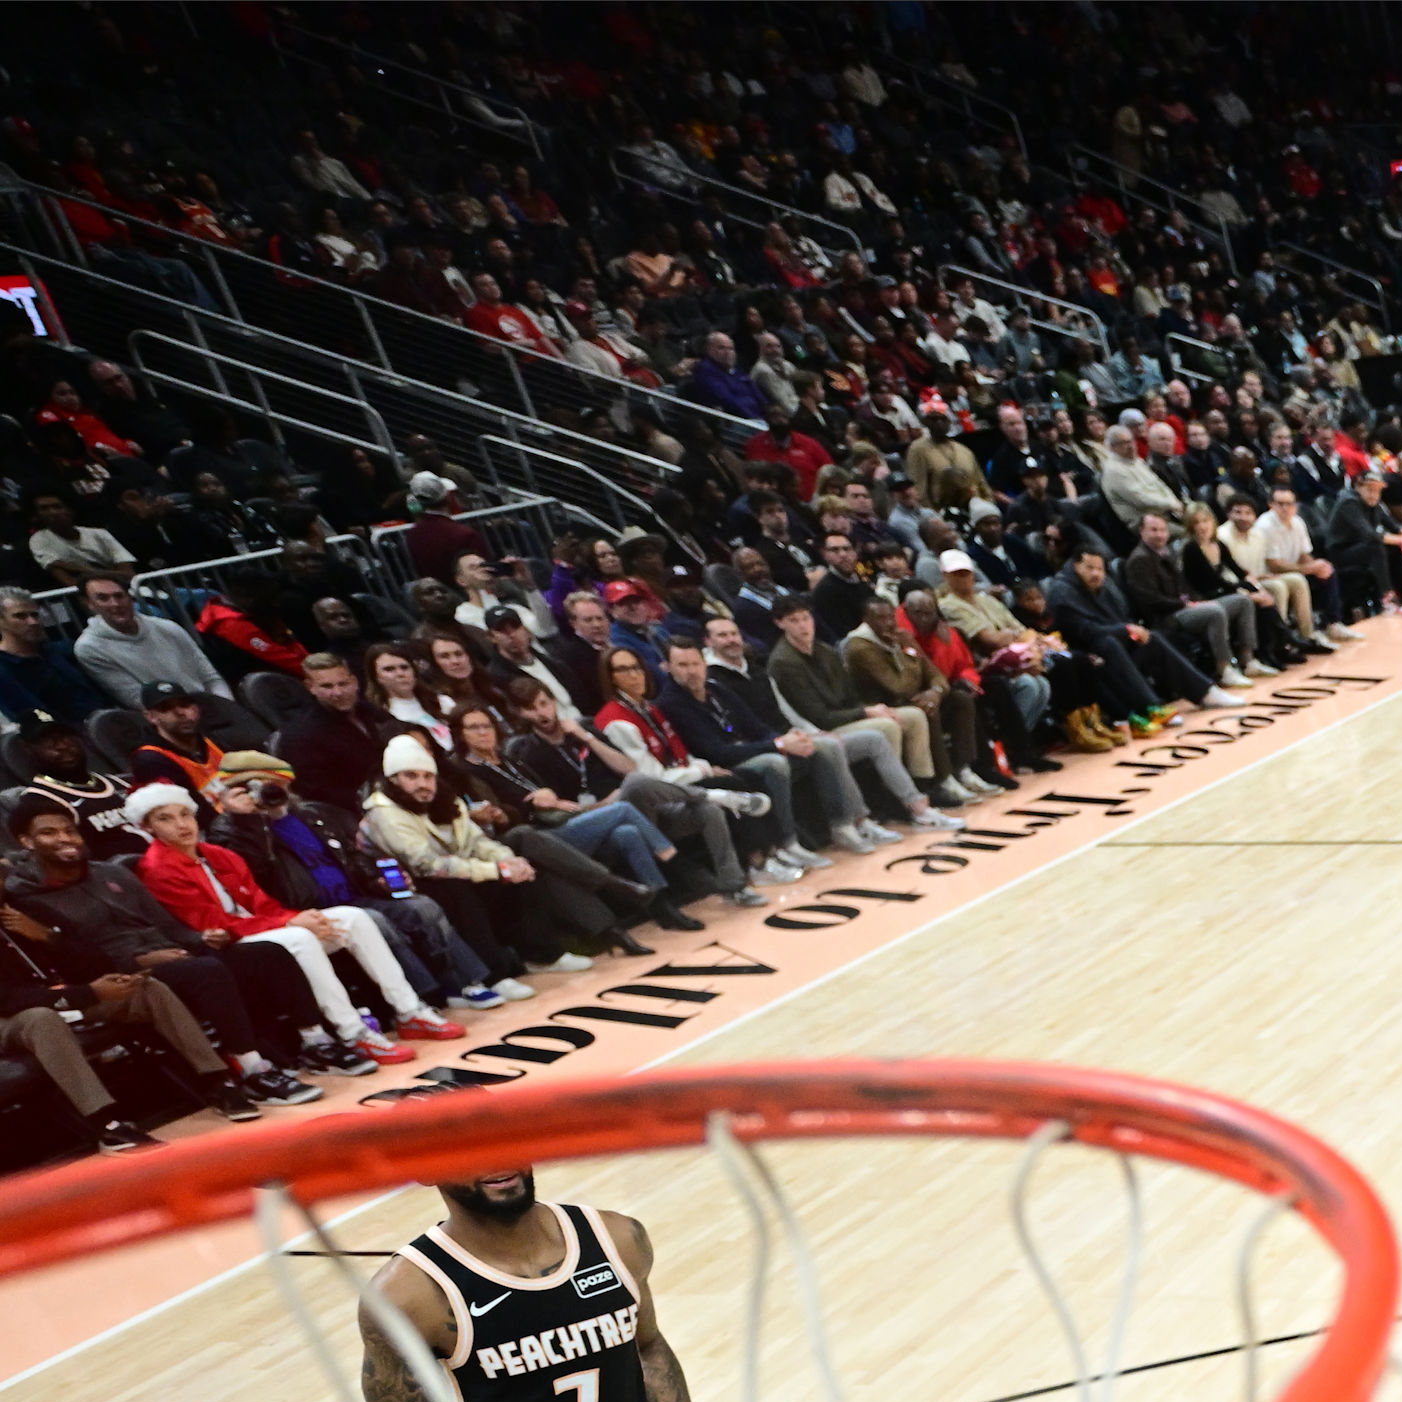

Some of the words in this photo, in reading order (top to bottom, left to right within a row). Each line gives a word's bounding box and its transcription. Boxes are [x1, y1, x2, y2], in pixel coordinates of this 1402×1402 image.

[362, 941, 777, 1105] Atlan
[577, 1270, 613, 1292] paze
[476, 1304, 639, 1379] PEACHTREE
